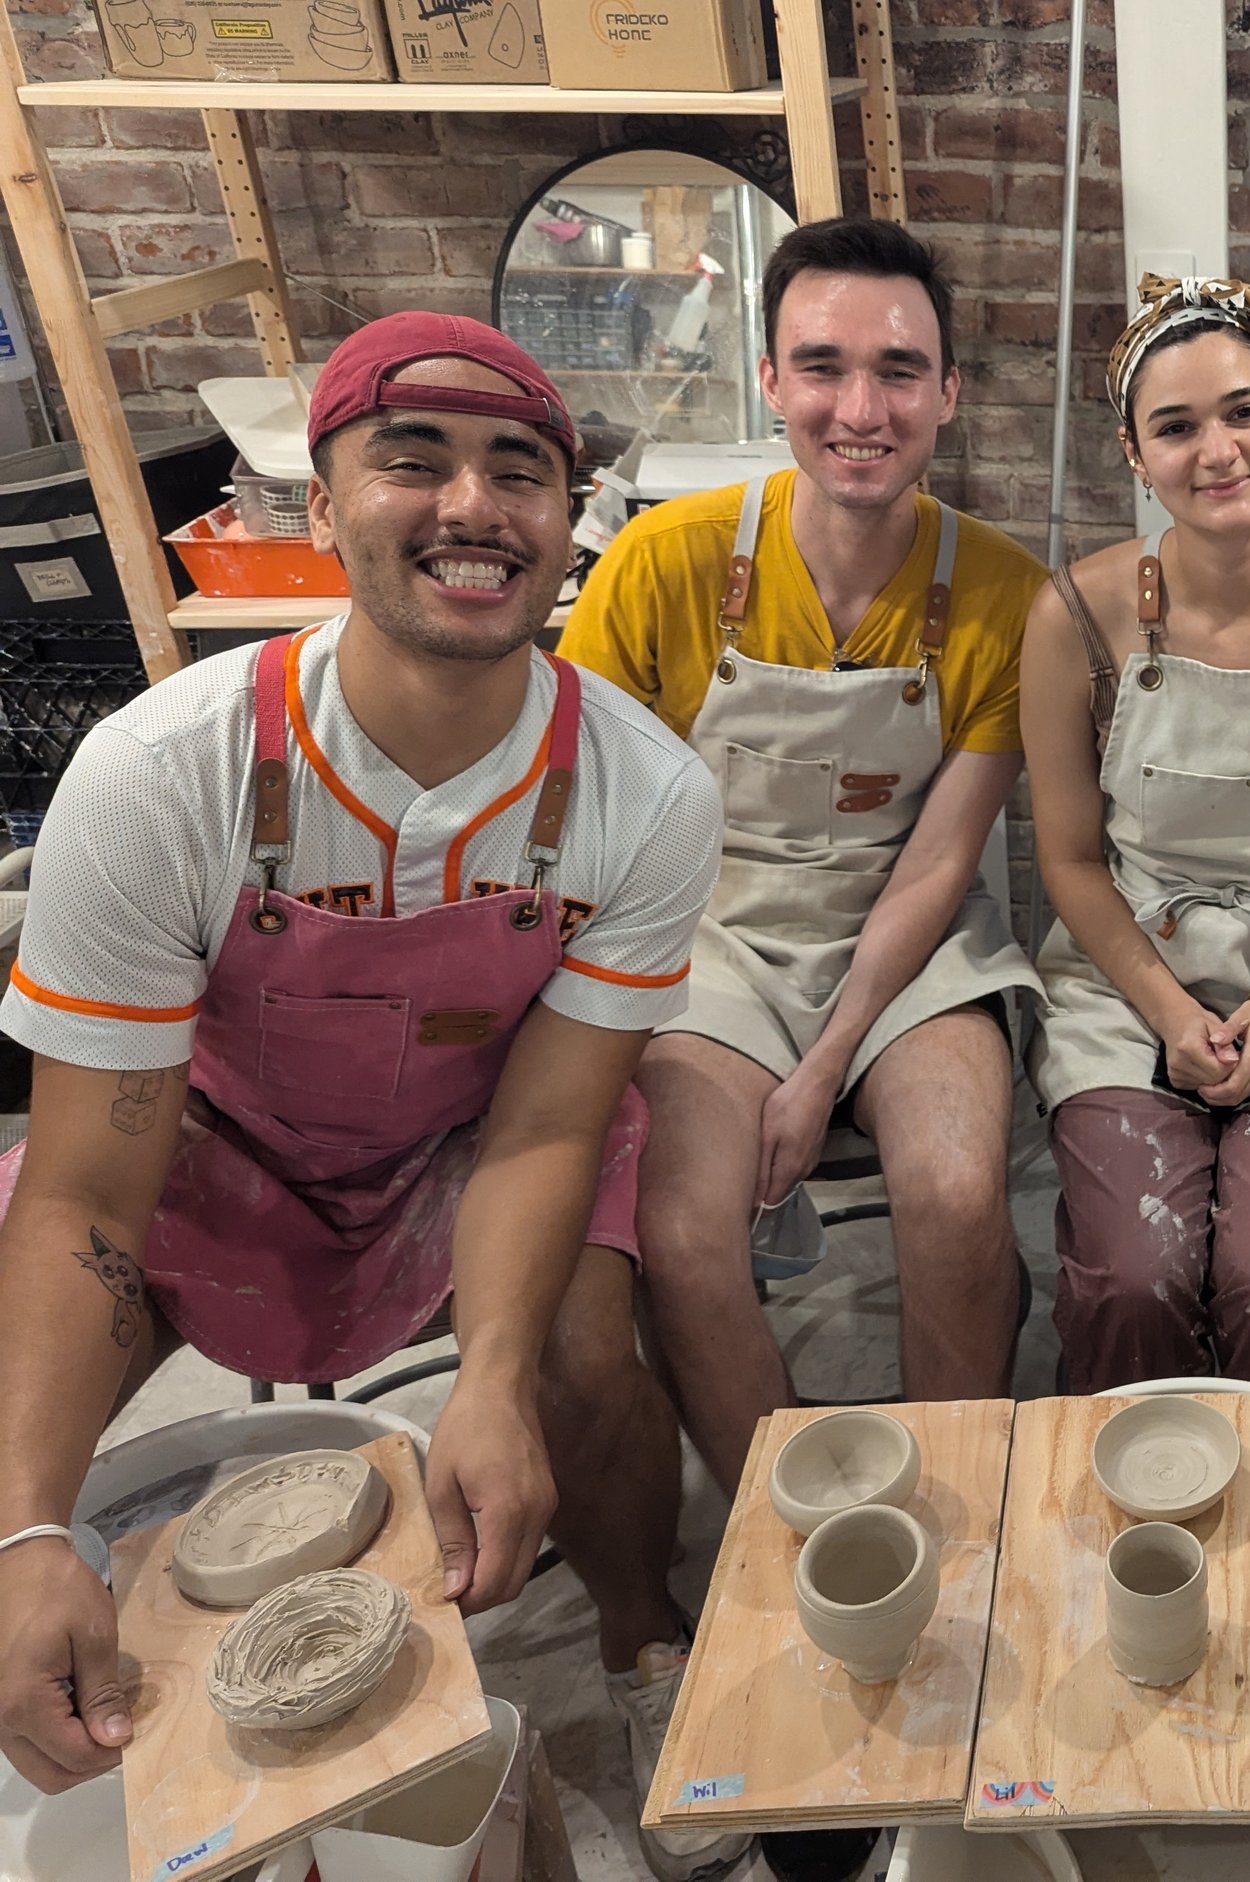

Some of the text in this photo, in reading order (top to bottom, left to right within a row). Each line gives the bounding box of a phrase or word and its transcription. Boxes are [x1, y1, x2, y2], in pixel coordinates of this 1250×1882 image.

[435, 19, 453, 31] CLAY
[459, 9, 495, 24] COMPANY
[692, 1781, 717, 1798] Wil
